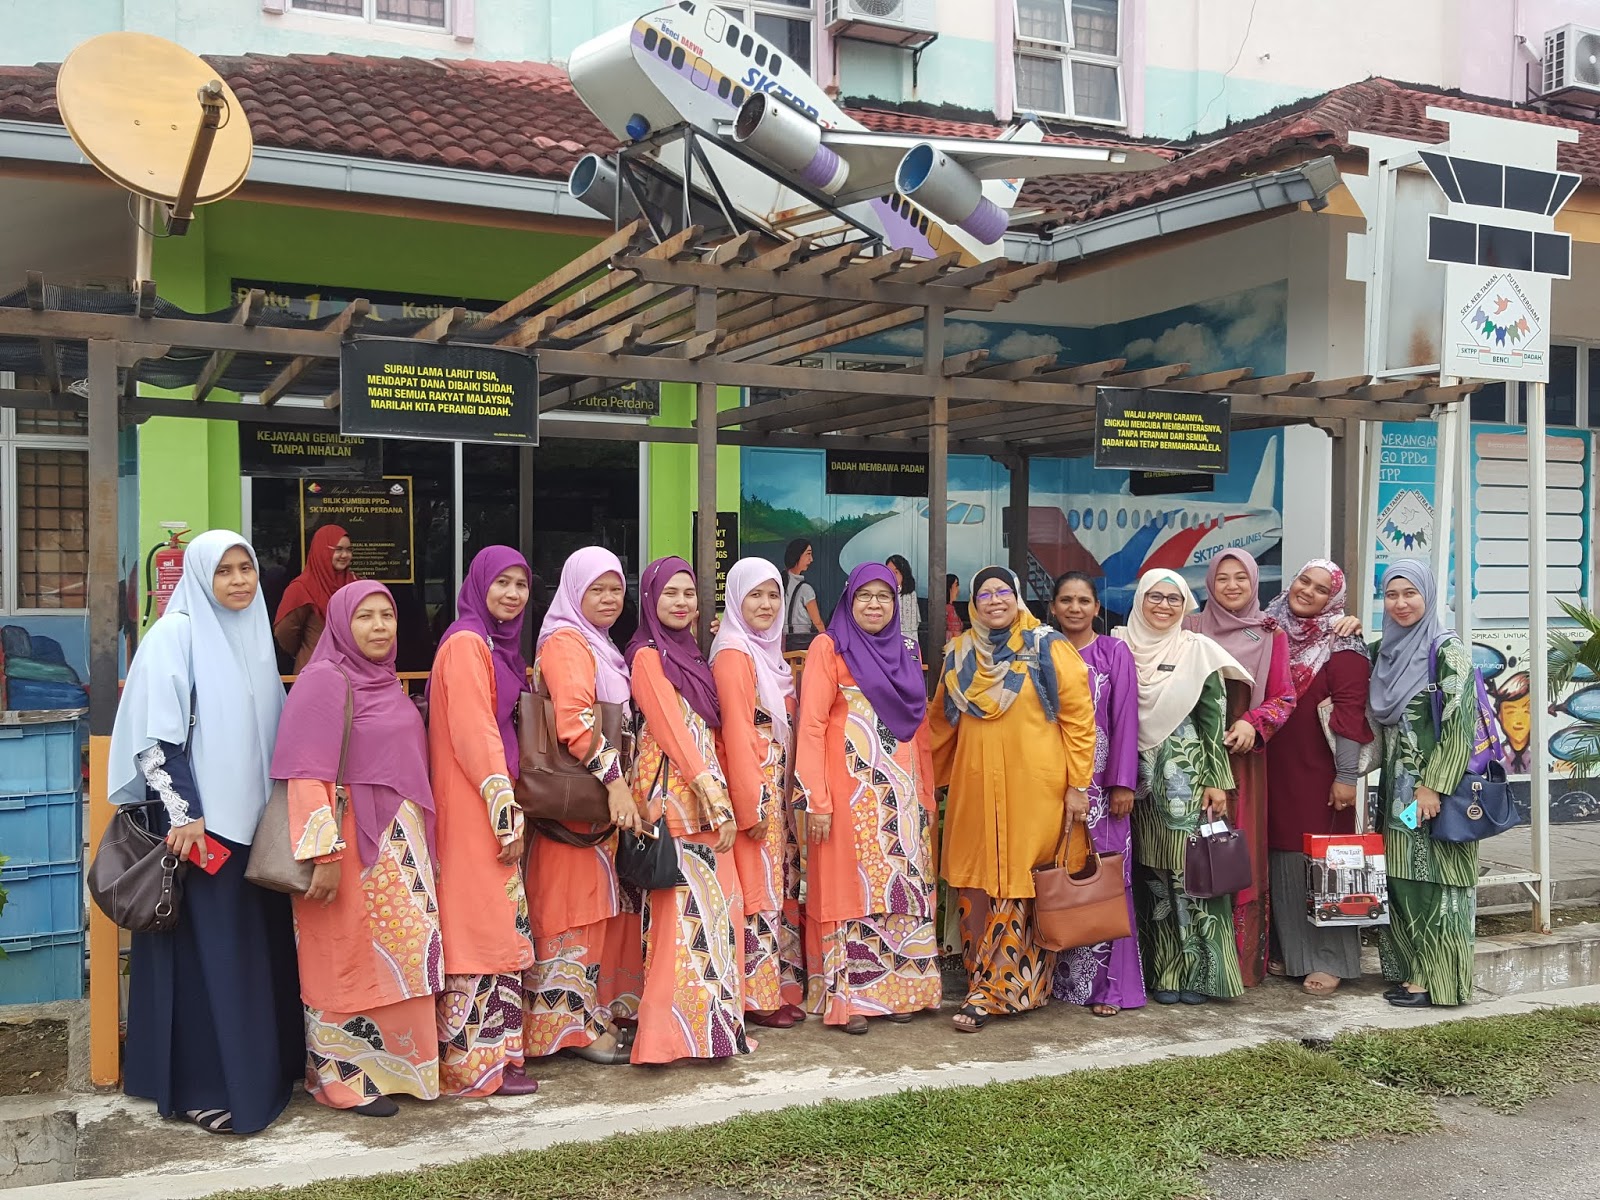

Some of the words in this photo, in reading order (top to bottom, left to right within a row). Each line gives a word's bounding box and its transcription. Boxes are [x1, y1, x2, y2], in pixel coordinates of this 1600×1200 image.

[1481, 274, 1498, 294] TAMAN
[237, 287, 290, 307] Ptu
[1507, 273, 1522, 295] PUTRA
[1520, 293, 1540, 322] PERDANA
[1492, 356, 1510, 364] BENCI
[1524, 353, 1542, 361] DADAH
[384, 363, 415, 375] SURAU
[417, 366, 443, 378] LAMA
[445, 368, 474, 379] LARUT
[476, 370, 499, 382] USIA,
[367, 375, 418, 387] MENDAPAT
[420, 378, 446, 389] DANA
[448, 380, 481, 392] DIBAIKI
[482, 383, 515, 395] SUDAH,
[368, 387, 392, 398] MARI
[394, 389, 427, 400] SEMUA
[428, 391, 464, 402] RAKYAT
[466, 393, 514, 407] MALAYSIA,
[610, 396, 654, 410] Perdana
[371, 399, 413, 411] MARILAH
[415, 401, 436, 413] KITA
[437, 403, 476, 415] PERANGI
[478, 406, 511, 417] DADAH.
[1124, 410, 1146, 419] WALAU
[1147, 411, 1172, 421] APAPUN
[1173, 413, 1204, 423] CARANYA,
[1104, 419, 1129, 428] ENGKAU
[1130, 420, 1161, 430] MENCUBA
[1162, 422, 1222, 434] MEMBANTERASNYA,
[257, 430, 310, 443] KEJAYAAN
[313, 433, 365, 445] GEMILANG
[1118, 429, 1139, 438] TANPA
[1139, 430, 1169, 440] PERANAN
[1170, 431, 1185, 440] DARI
[1186, 432, 1209, 442] SEMUA,
[271, 443, 305, 455] TANPA
[307, 445, 352, 457] INHALAN
[1102, 438, 1124, 447] DADAH
[1124, 439, 1139, 448] KAN
[1139, 440, 1159, 449] TETAP
[1160, 441, 1222, 452] BERMAHARAJALELA.
[1401, 451, 1428, 464] PPDa
[831, 461, 857, 471] DADAH
[858, 462, 899, 472] MEMBAWA
[900, 464, 925, 473] PADAH
[1379, 468, 1401, 480] TPP
[341, 497, 371, 505] SUMBER
[1415, 490, 1429, 507] PUTRA
[346, 506, 370, 514] PUTRA
[1228, 531, 1262, 549] AIRLINES
